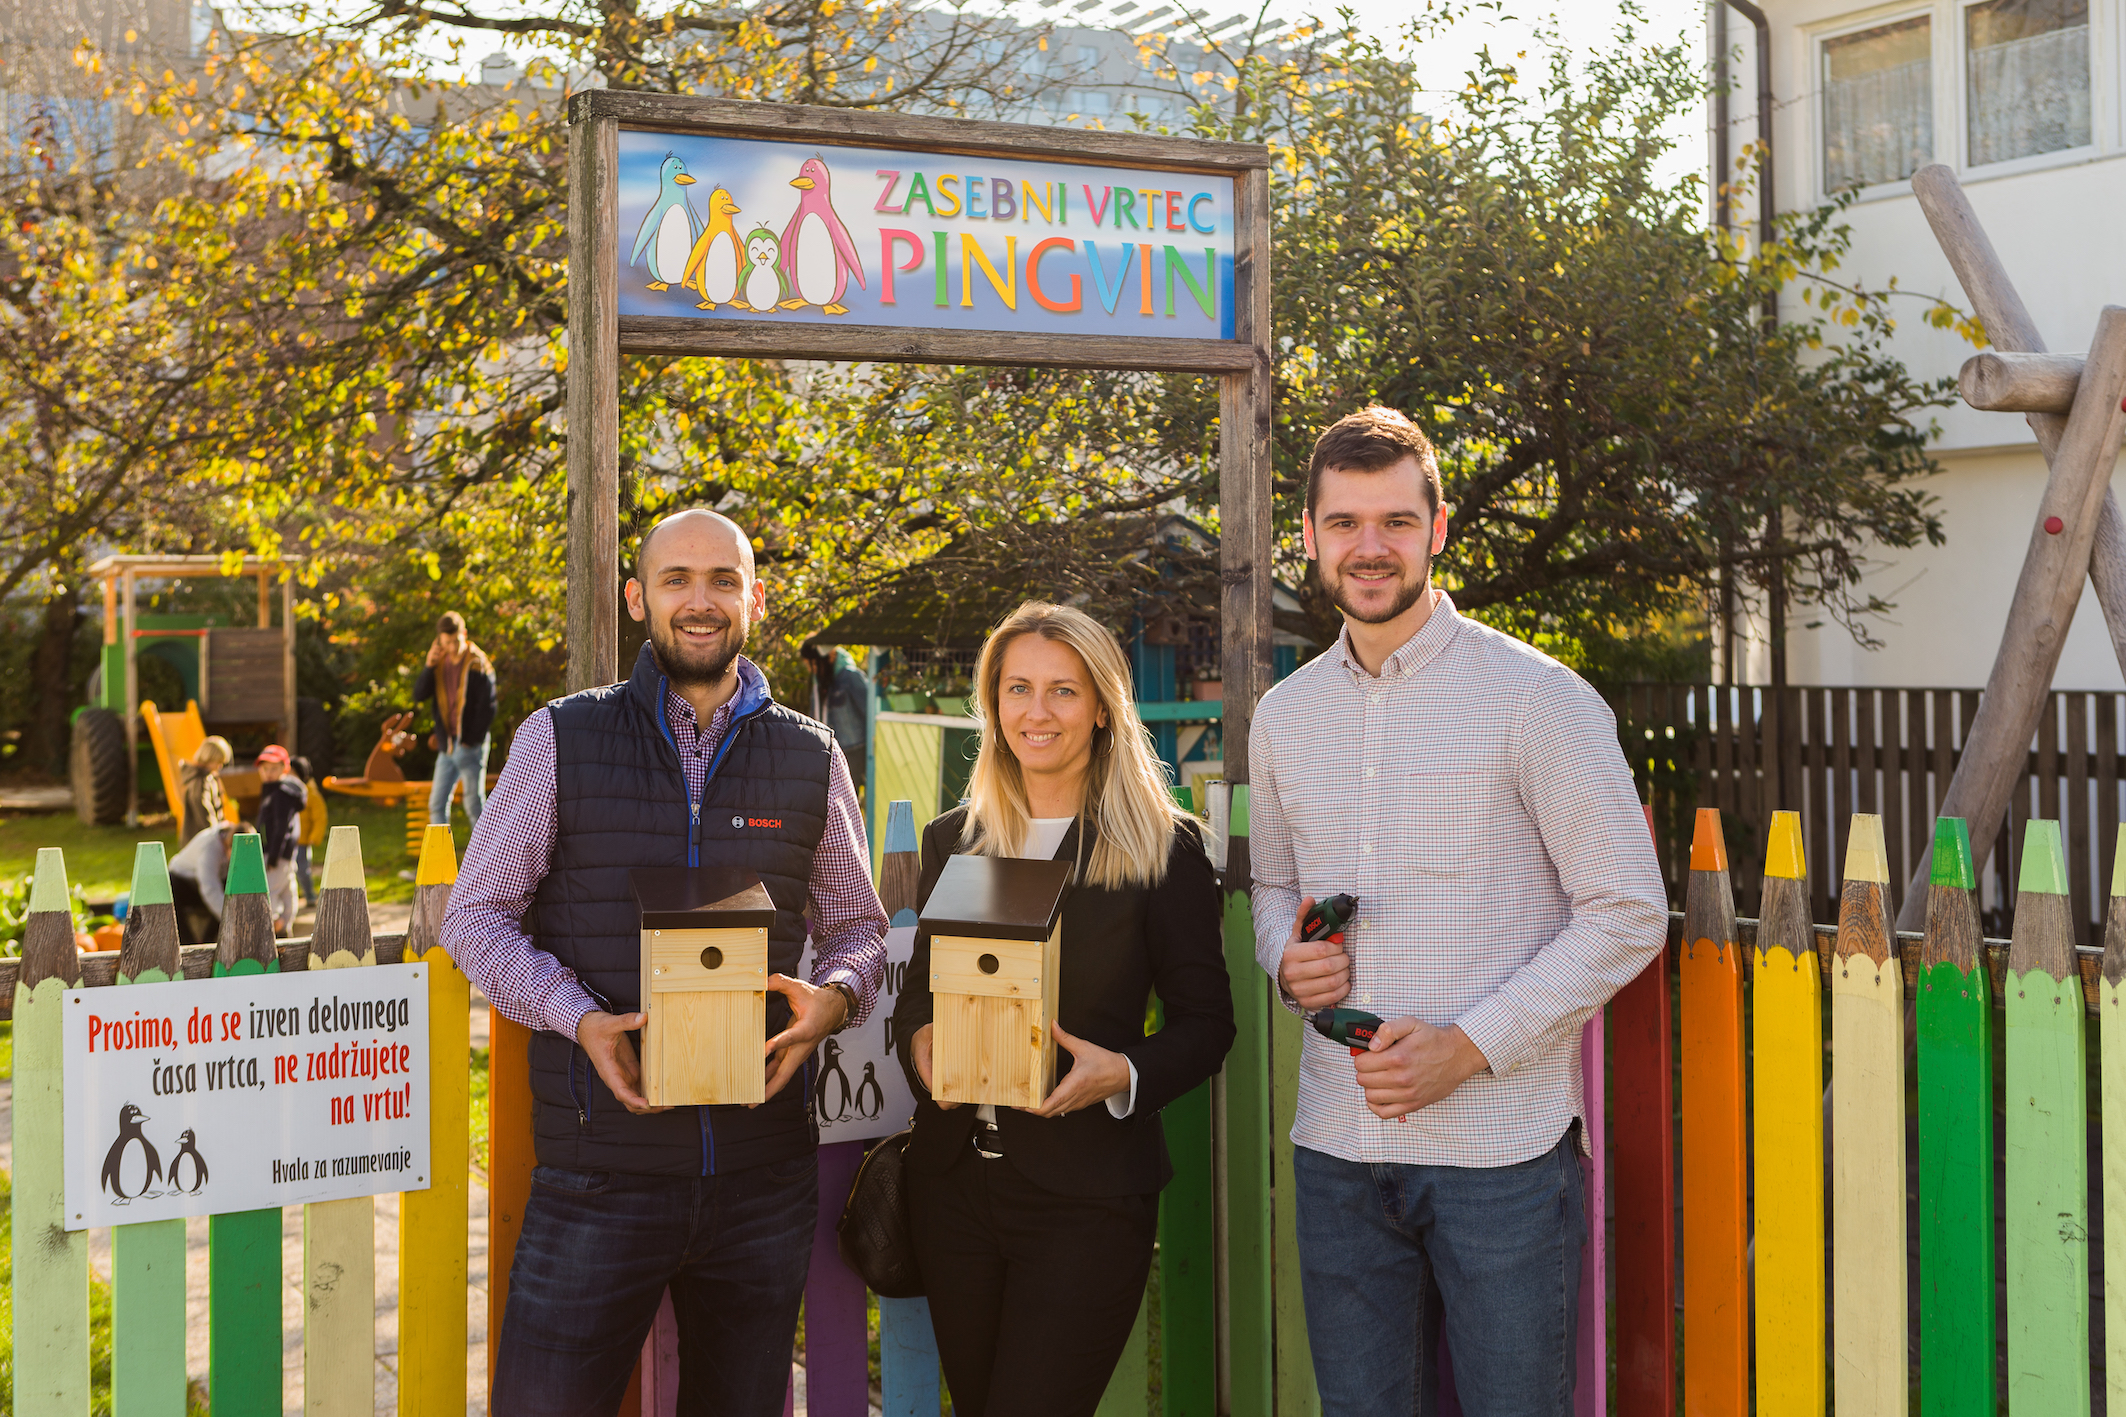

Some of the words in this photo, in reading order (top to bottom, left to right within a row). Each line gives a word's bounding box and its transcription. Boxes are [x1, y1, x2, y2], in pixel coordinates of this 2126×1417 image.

[873, 168, 1067, 224] ZASEBNI
[1083, 183, 1216, 234] VRTEC
[877, 227, 1217, 319] PINGVIN
[748, 818, 782, 829] BOSCH
[1305, 917, 1322, 934] BOSCH
[88, 1010, 178, 1053] Prosimo,
[187, 1006, 213, 1045] da
[221, 1011, 241, 1042] se
[249, 1002, 300, 1040] izven
[308, 995, 409, 1035] delovnega
[1355, 1028, 1376, 1039] BOS
[152, 1058, 197, 1096] časa
[205, 1055, 265, 1091] vrtca,
[274, 1054, 298, 1085] ne
[306, 1038, 410, 1082] zadržujete
[330, 1095, 355, 1126] na
[363, 1081, 411, 1123] vrtu!
[272, 1157, 309, 1184] Hvala
[314, 1159, 327, 1179] za
[332, 1145, 411, 1178] razumevanje
